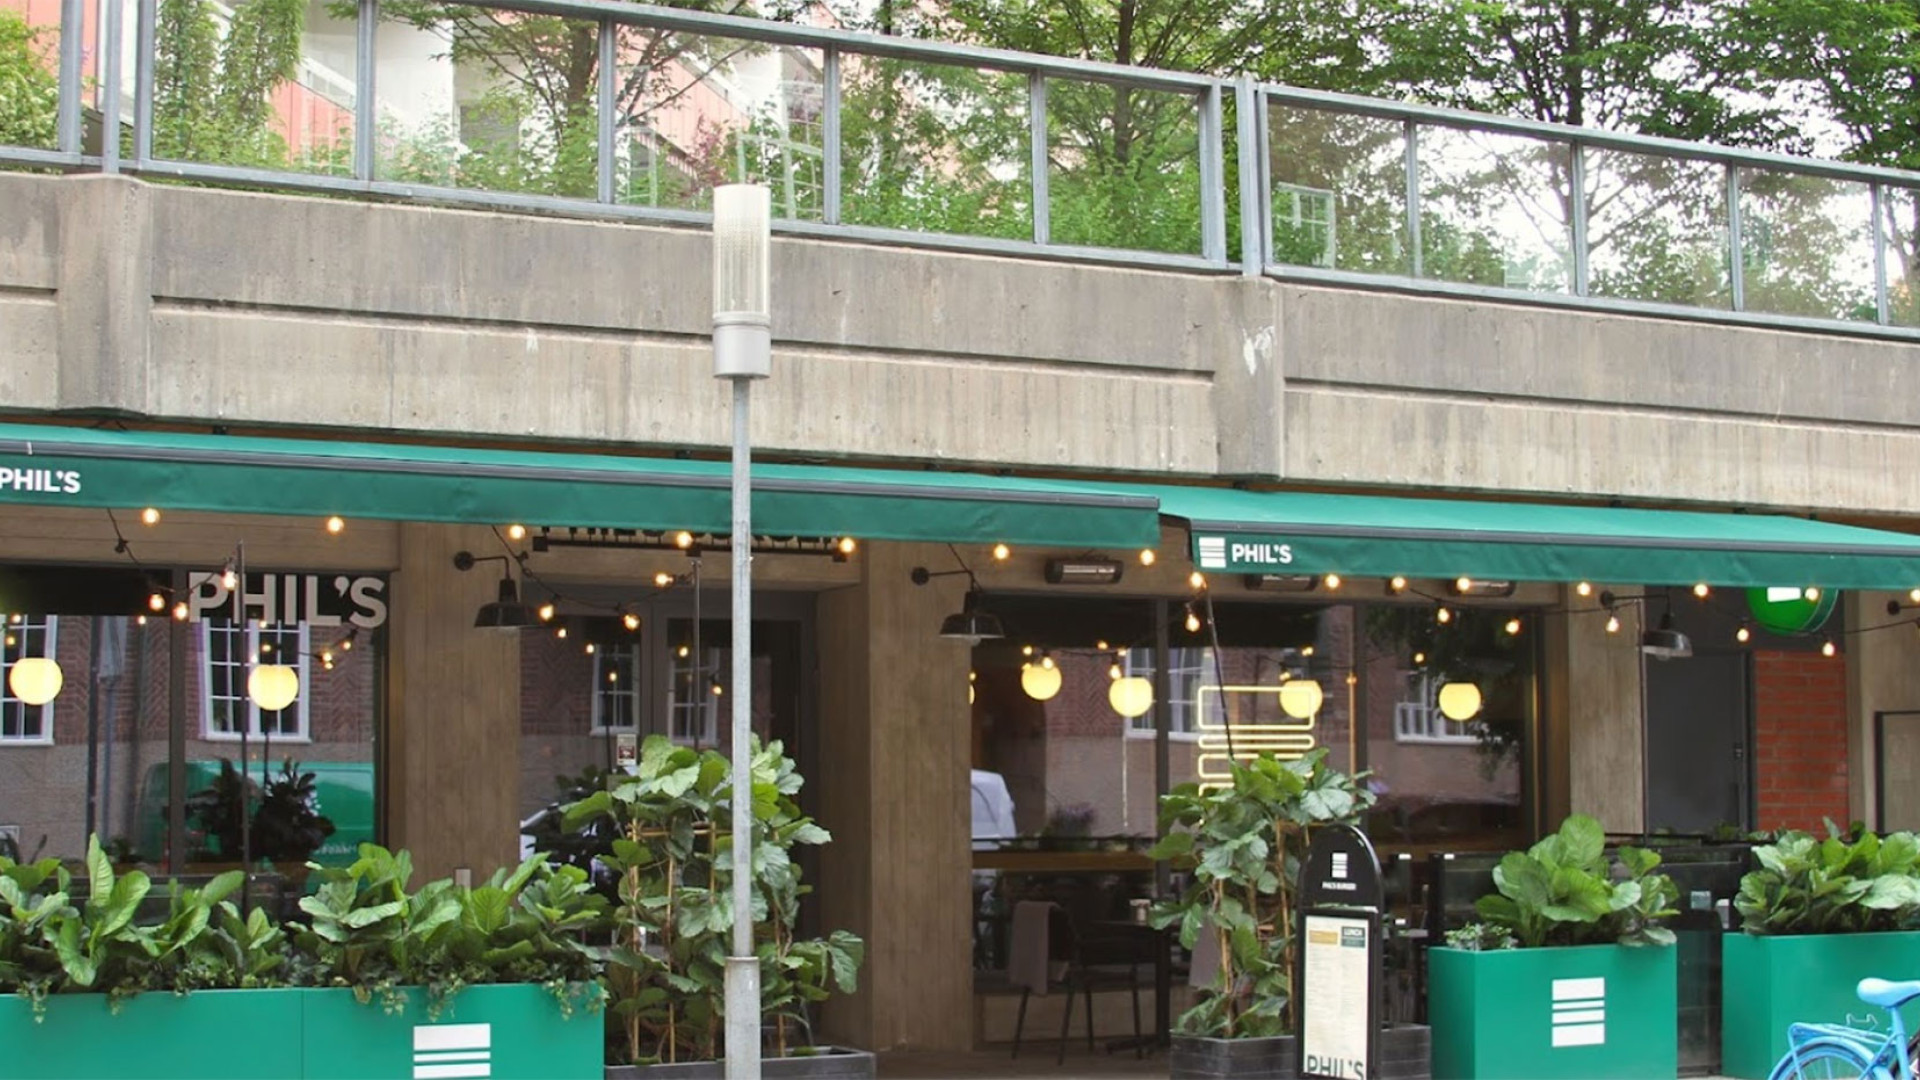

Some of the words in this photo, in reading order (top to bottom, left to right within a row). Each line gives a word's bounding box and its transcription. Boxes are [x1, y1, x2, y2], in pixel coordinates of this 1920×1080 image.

[0, 467, 81, 494] PHIL'S
[1231, 543, 1293, 564] PHIL'S
[189, 572, 388, 628] PHIL'S
